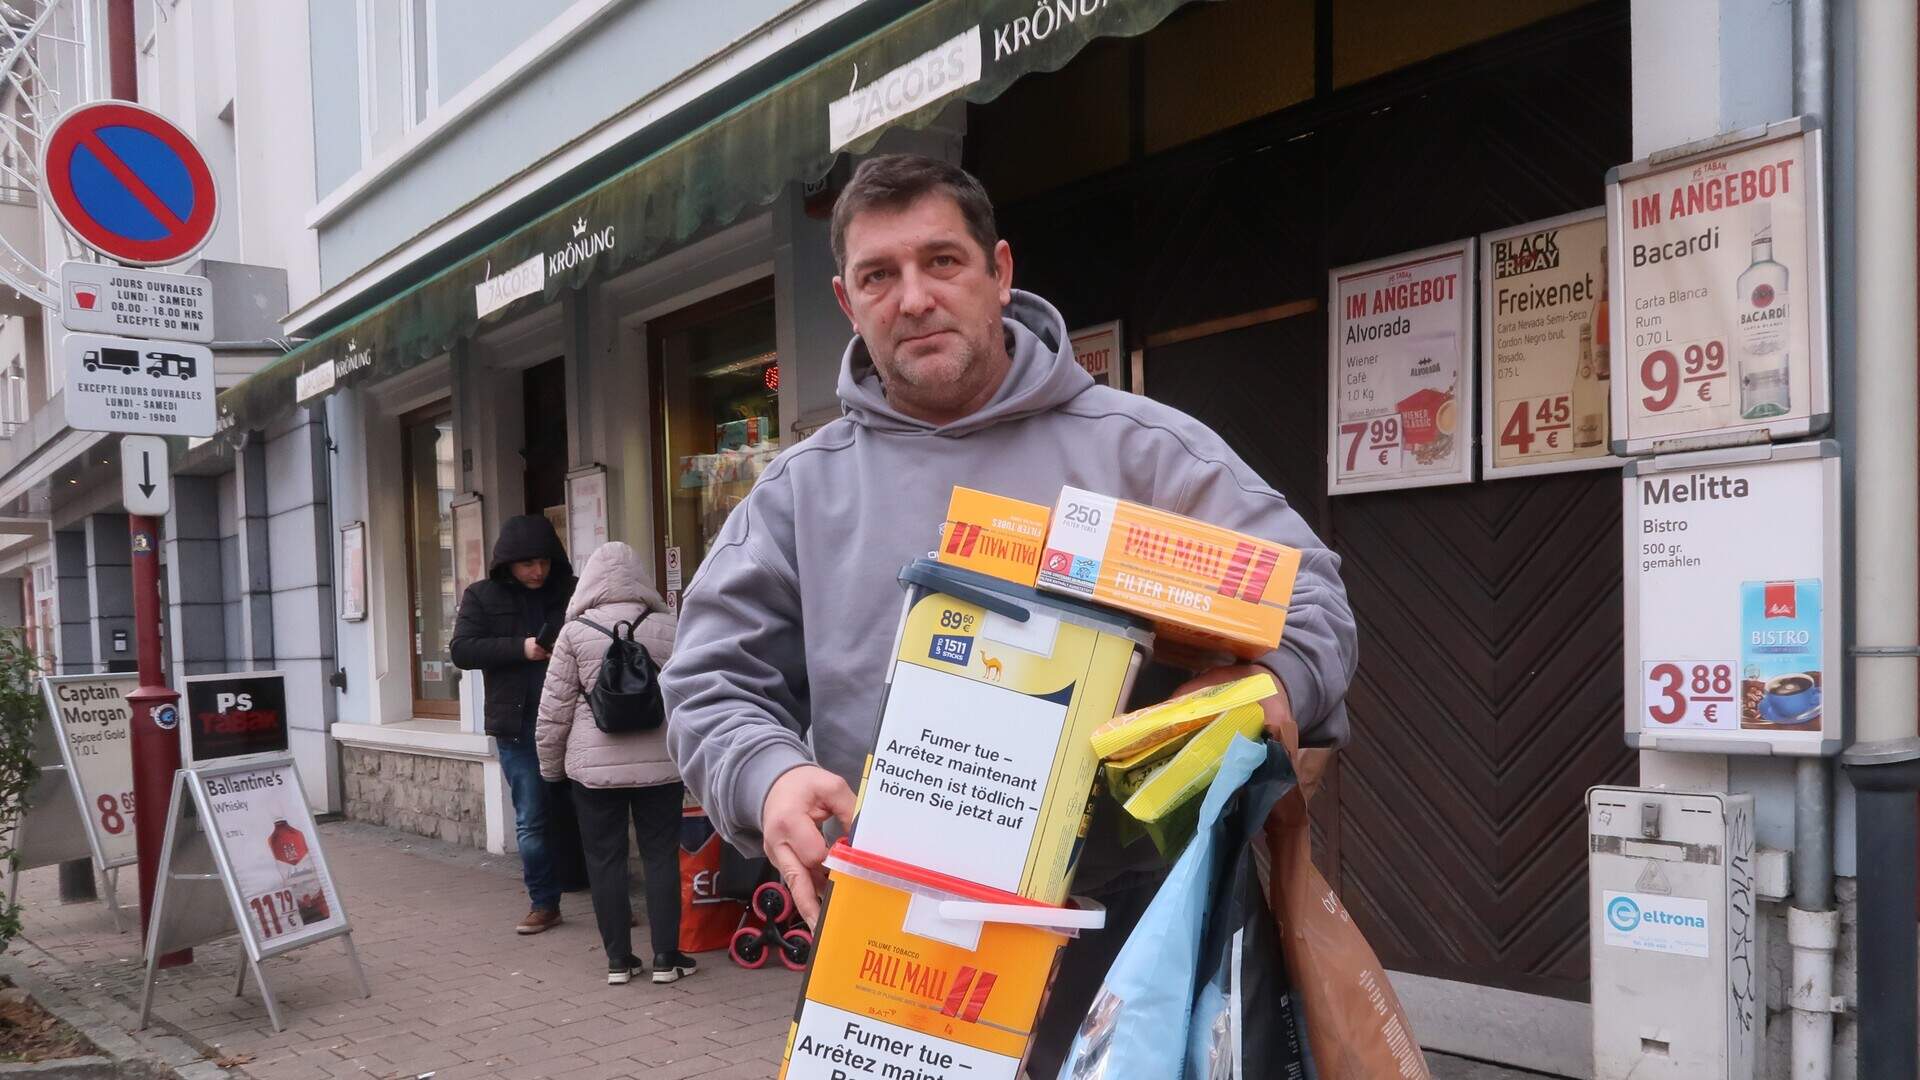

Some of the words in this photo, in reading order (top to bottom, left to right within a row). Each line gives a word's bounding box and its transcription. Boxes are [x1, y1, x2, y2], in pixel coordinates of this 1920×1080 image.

[993, 0, 1107, 61] KRÖNU
[1632, 193, 1660, 229] IM
[1670, 160, 1793, 220] ANGEBOT
[549, 226, 616, 277] KRÖNUNG
[1496, 230, 1559, 263] BLACK
[1633, 226, 1720, 267] Bacardi
[1496, 249, 1559, 278] FRIDAY
[110, 278, 143, 289] JOURS
[147, 281, 203, 296] OUVRABLES
[1346, 293, 1367, 320] IM
[1372, 274, 1457, 315] ANGEBOT
[1498, 272, 1593, 316] Freixenet
[117, 290, 148, 302] LUNDI
[160, 295, 196, 307] SAMEDI
[1635, 295, 1665, 311] Carta
[1669, 286, 1708, 304] Blanca
[112, 302, 141, 313] 08.00
[153, 306, 180, 318] 18.00
[184, 310, 204, 320] HRS
[117, 314, 160, 327] EXCEPTE
[164, 319, 176, 329] 90
[181, 321, 200, 331] MIN
[1346, 316, 1411, 345] Alvorada
[1497, 322, 1517, 334] Carta
[1518, 318, 1544, 331] Nevada
[1635, 315, 1662, 329] Rum
[1497, 336, 1522, 349] Cordon
[1525, 333, 1547, 346] Negro
[1635, 332, 1662, 347] 0.70
[1666, 331, 1673, 342] L
[335, 348, 372, 380] KRÖNUNG
[1346, 354, 1379, 368] Wiener
[78, 383, 117, 395] EXCEPTE
[121, 385, 148, 396] JOURS
[151, 388, 202, 400] OUVRABLES
[1362, 388, 1374, 401] Kg
[1697, 382, 1712, 401] €
[106, 398, 133, 408] LUNDI
[143, 400, 178, 410] SAMEDI
[110, 411, 139, 421] 07h00
[150, 413, 177, 423] 19h00
[1546, 431, 1559, 448] €
[1378, 450, 1389, 465] €
[1643, 473, 1749, 505] Melitta
[1065, 502, 1102, 527] 250
[1643, 518, 1688, 534] Bistro
[979, 534, 1010, 560] MALL
[1011, 542, 1038, 566] PALL
[1123, 526, 1170, 565] PALL
[1171, 533, 1223, 579] MALL
[1642, 542, 1666, 555] 500
[1668, 543, 1683, 556] gr.
[1642, 555, 1701, 572] gemahlen
[1115, 572, 1164, 599] FILTER
[1167, 585, 1213, 612] TUBES
[940, 609, 963, 629] 89
[944, 639, 967, 654] 1511
[1751, 630, 1809, 646] BISTRO
[942, 650, 964, 661] STICKS
[57, 683, 120, 705] Captain
[63, 706, 127, 726] Morgan
[1703, 703, 1718, 723] €
[71, 729, 102, 745] Spiced
[104, 728, 126, 741] Gold
[920, 729, 971, 753] Fumer
[975, 744, 1000, 763] tue
[886, 739, 944, 766] Arrêtez
[948, 758, 1038, 792] maintenant
[874, 758, 943, 789] Rauchen
[947, 778, 968, 795] ist
[971, 782, 1025, 811] tödlich
[213, 800, 249, 814] Whisky
[880, 778, 925, 803] hören
[929, 792, 954, 811] Sie
[956, 800, 993, 822] jetzt
[996, 813, 1023, 829] auf
[288, 914, 297, 927] €
[1643, 910, 1705, 928] eltrona
[867, 939, 893, 952] VOLUME
[892, 946, 920, 960] TOBACCO
[859, 949, 901, 988] PALL
[901, 958, 948, 1002] MALL
[797, 1034, 877, 1073] Arrêtez
[843, 1022, 913, 1057] Fumer
[919, 1045, 953, 1069] tue
